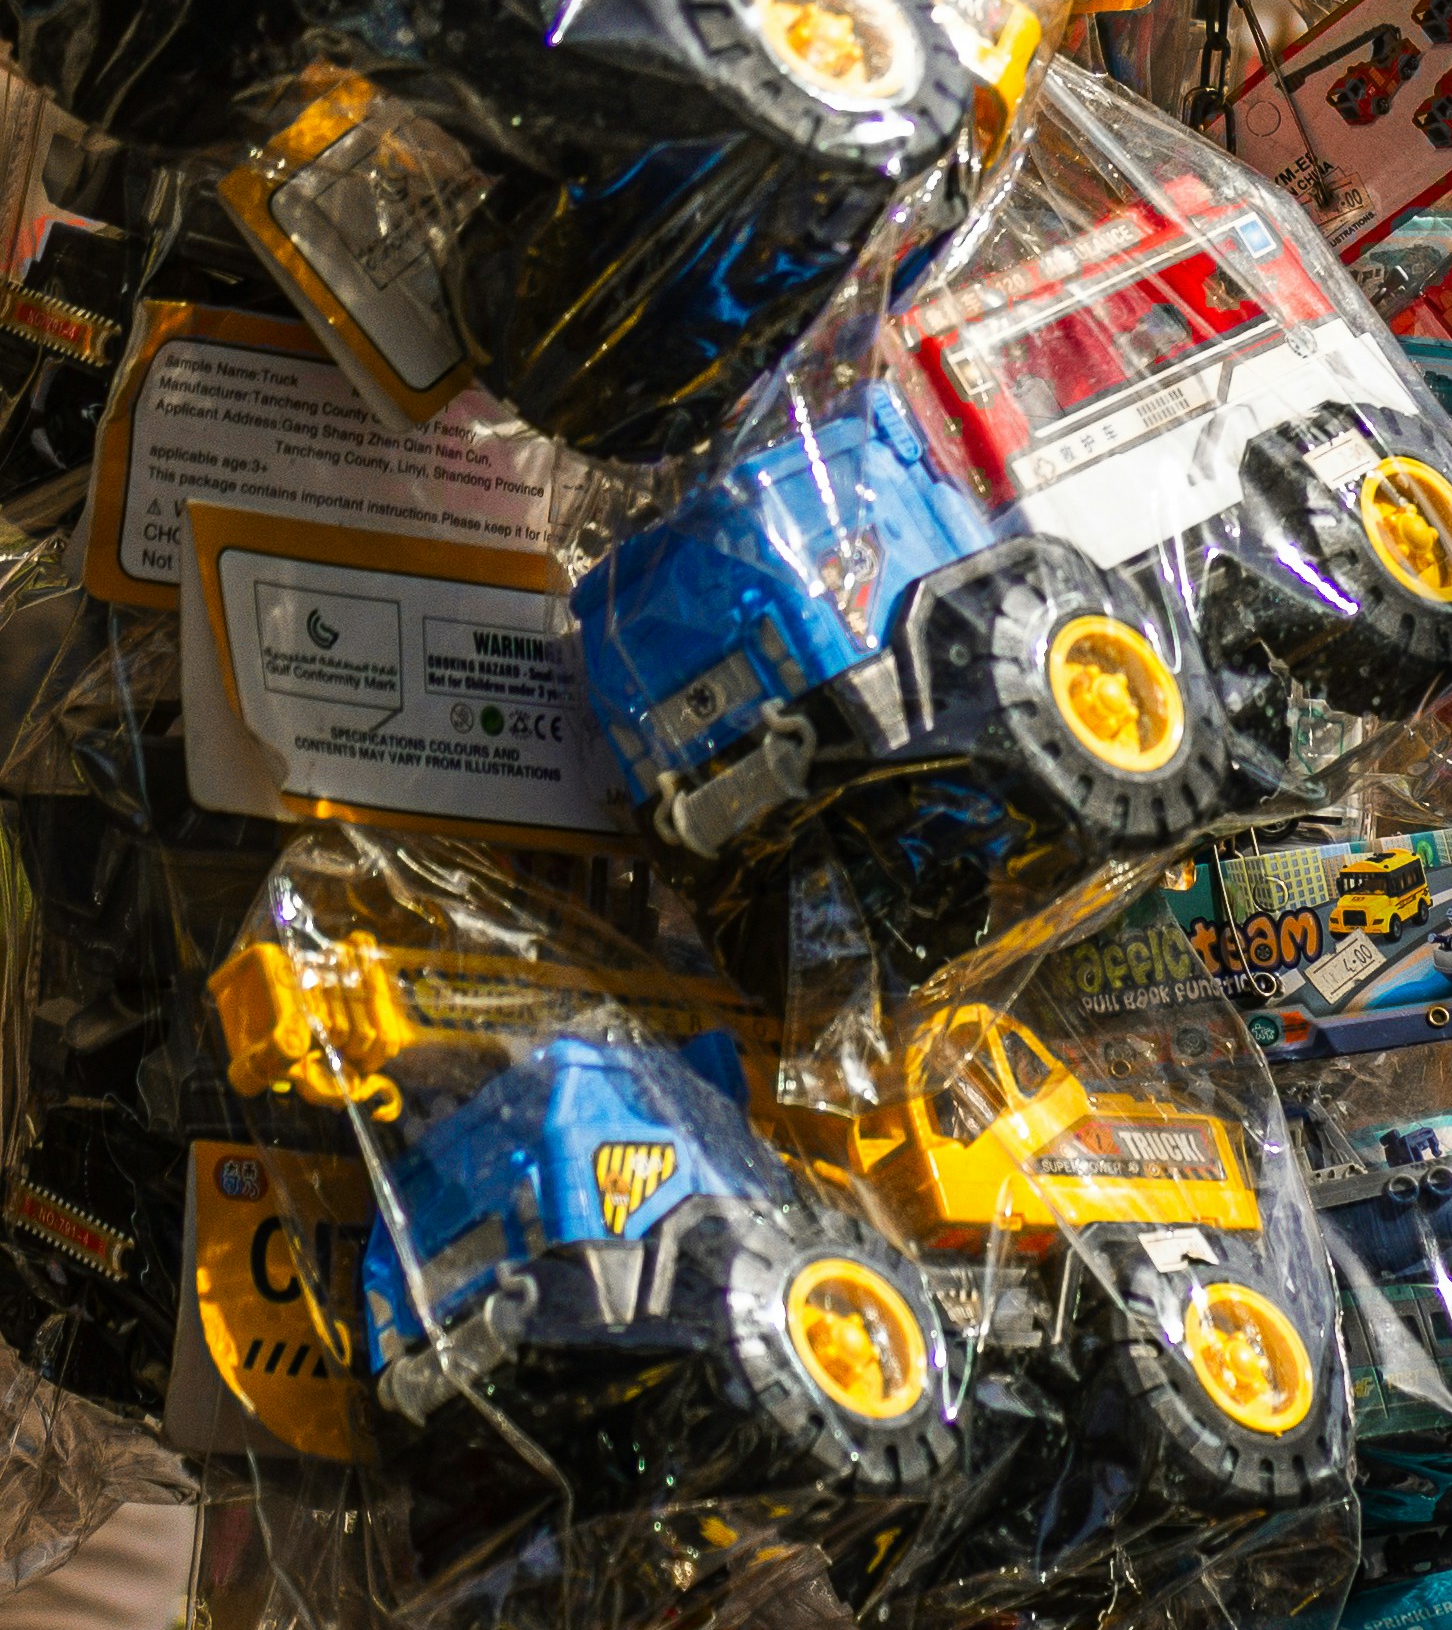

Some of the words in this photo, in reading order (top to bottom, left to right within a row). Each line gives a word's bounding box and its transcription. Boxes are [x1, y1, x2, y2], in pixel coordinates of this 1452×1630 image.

[165, 354, 213, 373] Sample
[156, 398, 218, 421] Applicant
[322, 424, 365, 447] Shang
[367, 433, 400, 452] Zhen
[435, 445, 463, 462] Nian
[322, 402, 368, 424] County
[434, 423, 477, 445] Factory
[150, 445, 219, 467] applicable
[275, 441, 341, 466] Tancheng
[433, 465, 492, 491] Shandong
[495, 478, 545, 498] Province
[149, 465, 176, 485] This
[179, 471, 237, 494] package
[240, 482, 298, 502] contains
[300, 489, 363, 512] important
[484, 521, 512, 539] keep
[525, 527, 541, 541] for
[142, 548, 174, 570] Not
[264, 659, 291, 678] Gulf
[293, 663, 362, 691] Conformity
[364, 675, 397, 694] Mark
[295, 735, 358, 759] CONTENTS
[358, 744, 386, 763] MAY
[388, 749, 423, 768] VARY
[425, 754, 463, 772] FROM
[464, 759, 563, 783] ILLUSTRATIONS
[330, 725, 427, 753] SPECIFICATIONS
[429, 741, 490, 762] COLOURS
[493, 746, 521, 764] AND
[1118, 1130, 1206, 1163] TRUCK!
